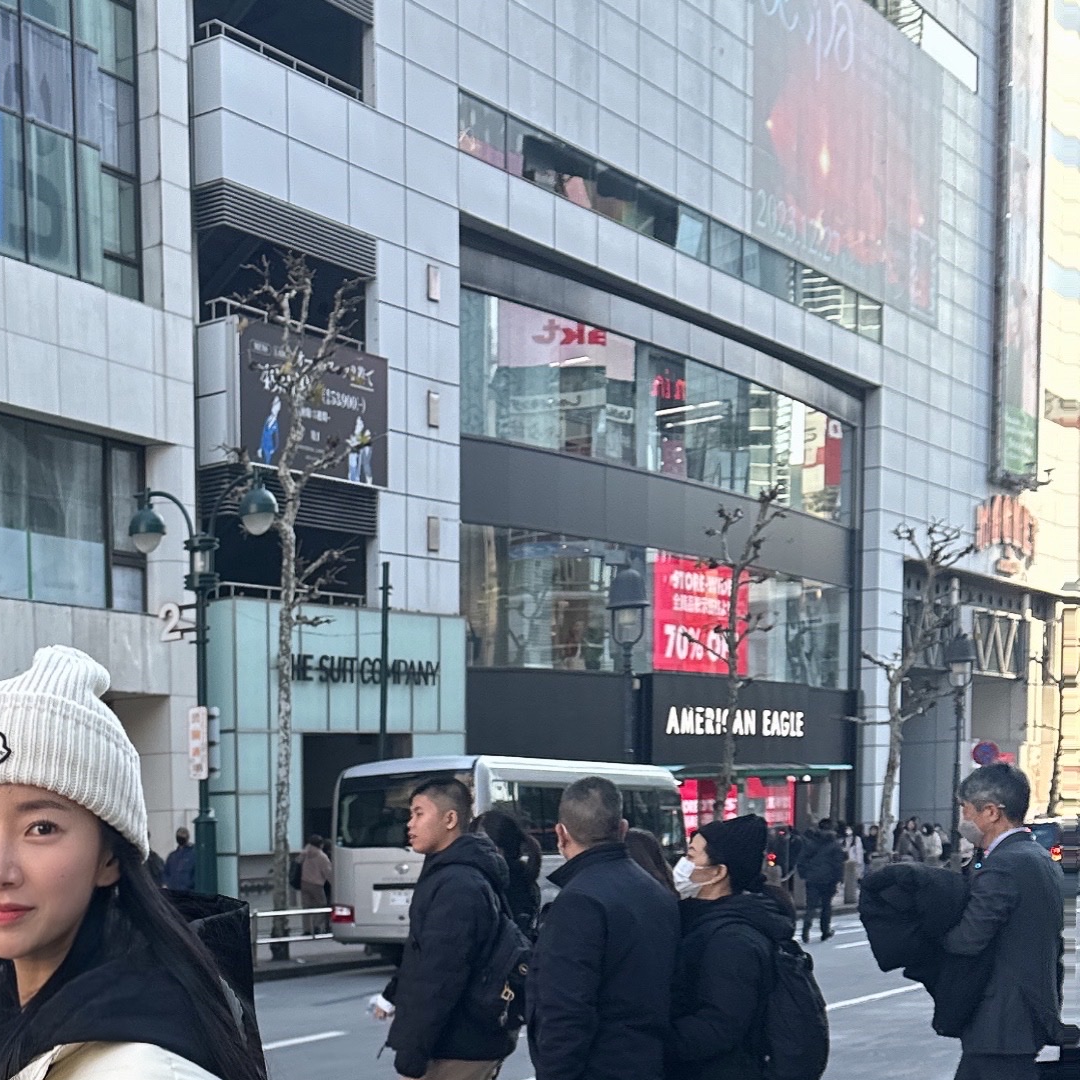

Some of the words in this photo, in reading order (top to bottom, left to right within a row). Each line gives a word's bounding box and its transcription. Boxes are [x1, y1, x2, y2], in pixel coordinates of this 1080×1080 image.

[159, 602, 184, 642] 2
[663, 623, 705, 661] 70%
[290, 653, 314, 682] HE
[318, 654, 358, 684] SUIT
[762, 708, 805, 738] EAGLE
